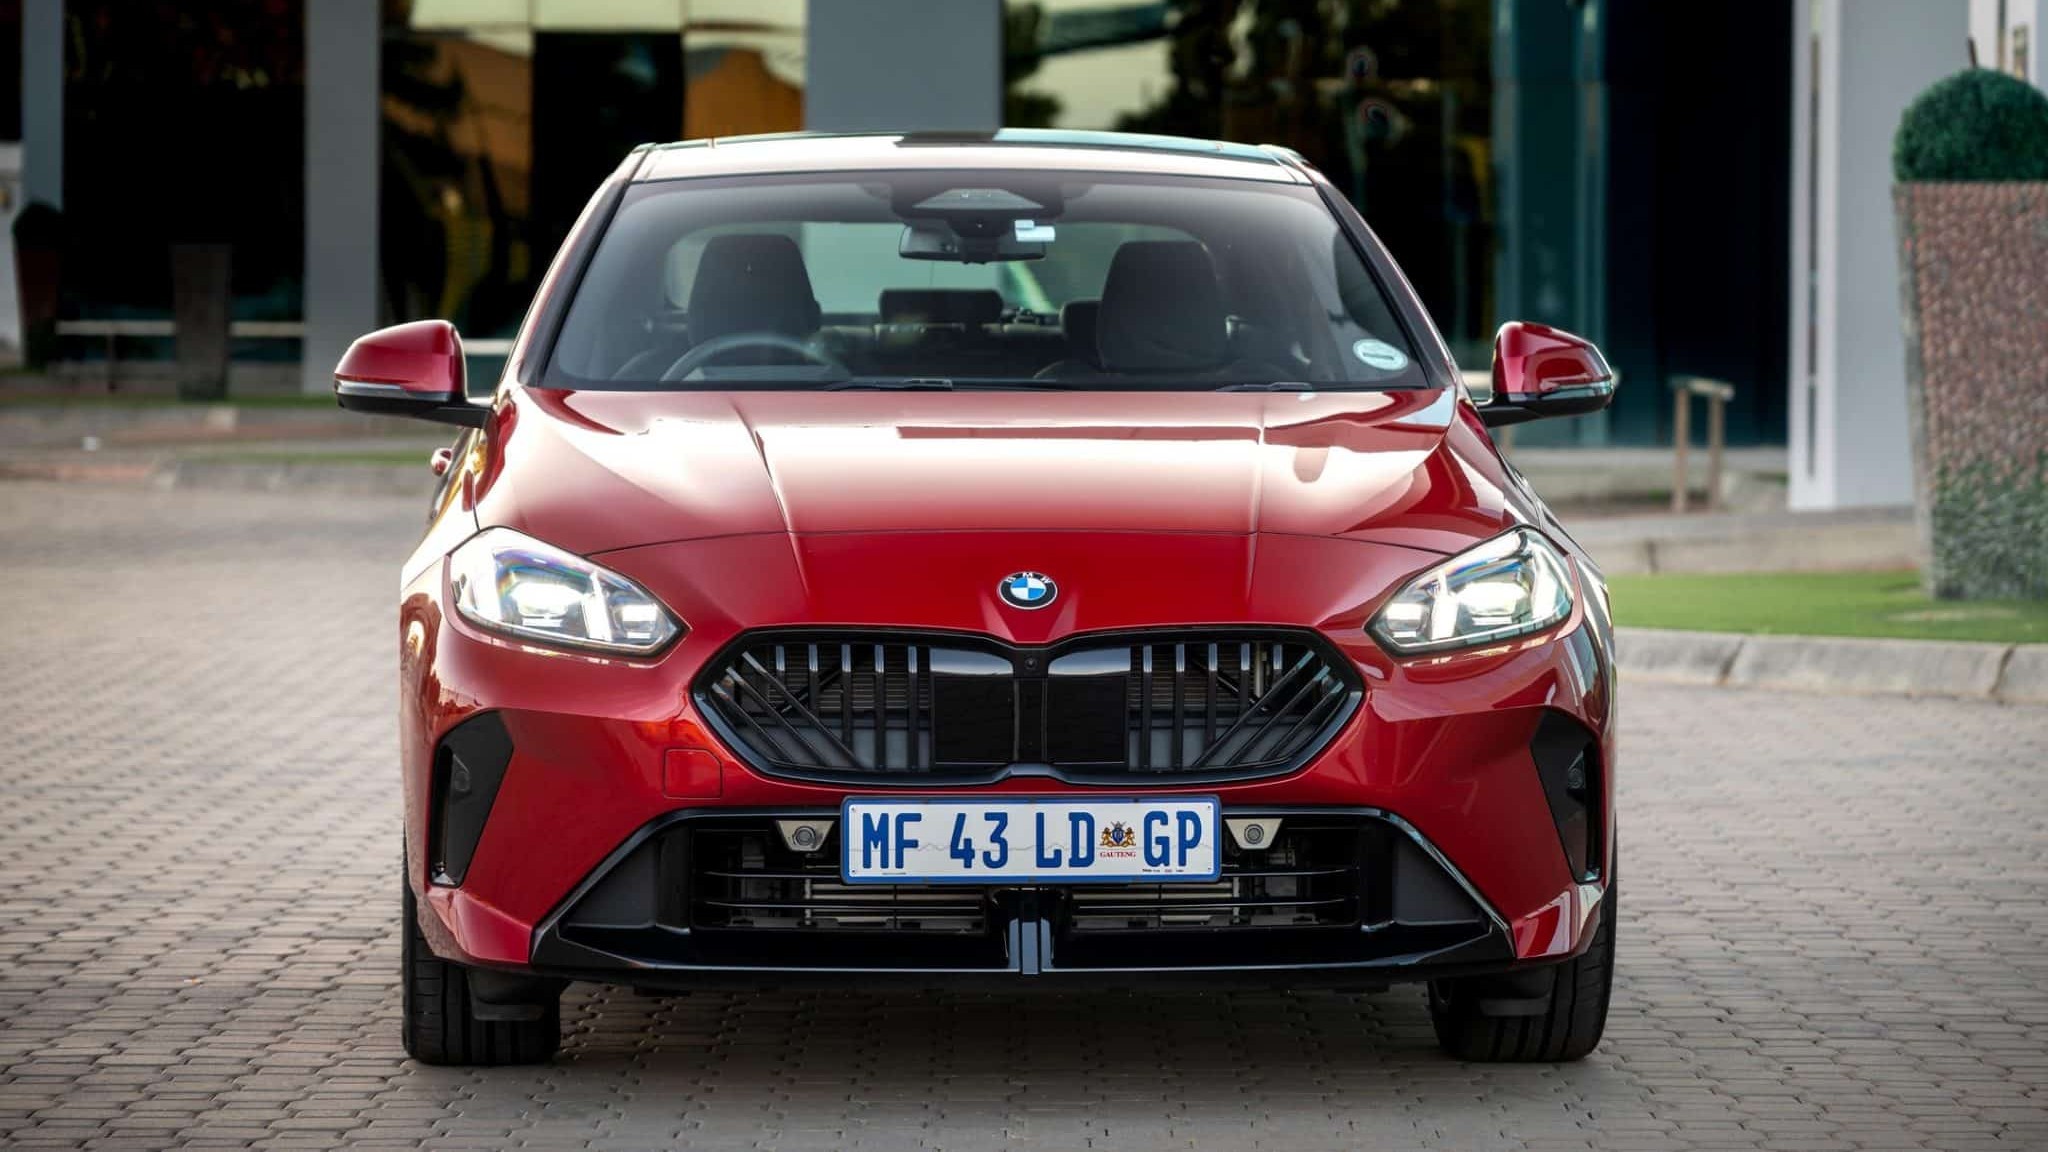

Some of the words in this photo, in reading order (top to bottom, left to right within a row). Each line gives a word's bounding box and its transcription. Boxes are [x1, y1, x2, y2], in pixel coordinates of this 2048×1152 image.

[1004, 571, 1051, 584] BMW
[862, 812, 922, 869] MF
[950, 812, 1009, 869] 43
[1035, 812, 1095, 868] LD
[1143, 810, 1202, 868] GP
